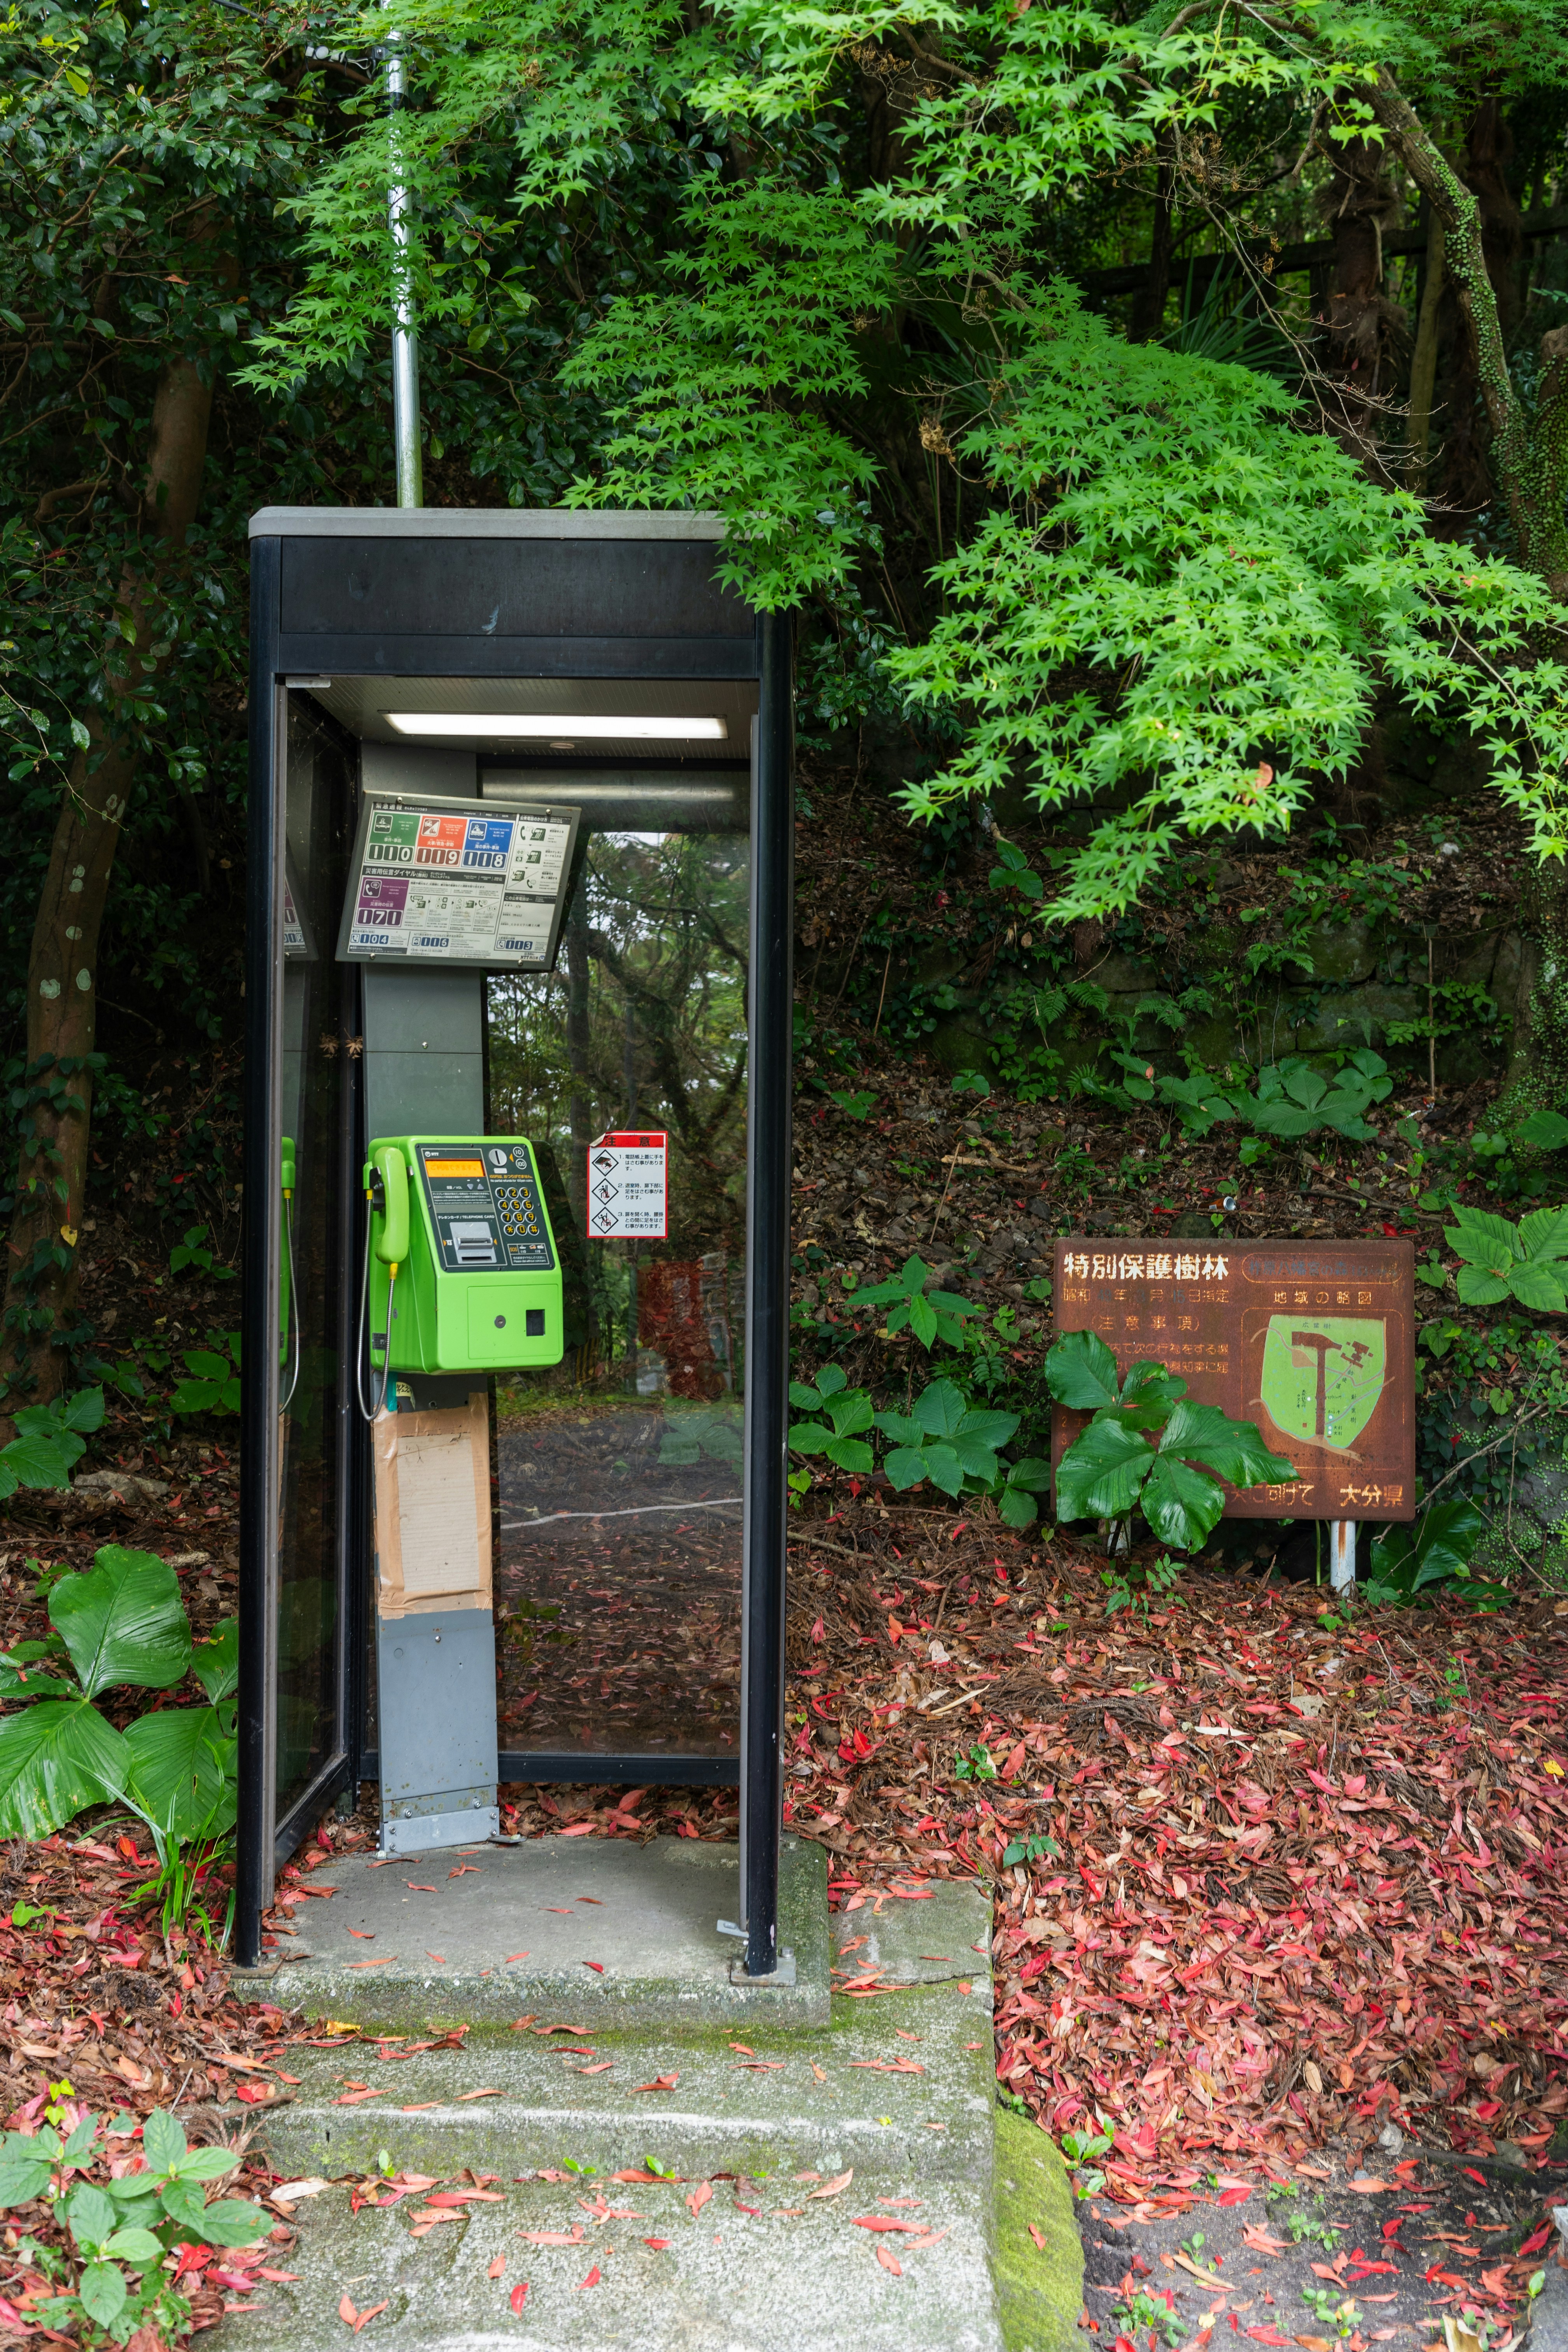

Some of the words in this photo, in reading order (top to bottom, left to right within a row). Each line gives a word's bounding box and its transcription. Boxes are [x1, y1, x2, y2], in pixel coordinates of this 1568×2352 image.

[374, 846, 410, 861] 110
[422, 849, 457, 864] 119
[468, 852, 503, 867] 118
[363, 910, 397, 924] 171
[364, 935, 387, 944] 104
[424, 938, 447, 947] 116
[509, 941, 531, 950] 113
[605, 1136, 650, 1146] 注意
[1064, 1253, 1228, 1280] 特別保護樹林
[1274, 1291, 1372, 1304] 地域の略図
[1092, 1315, 1199, 1332] (注意事項)
[1340, 1483, 1404, 1508] 大分県
